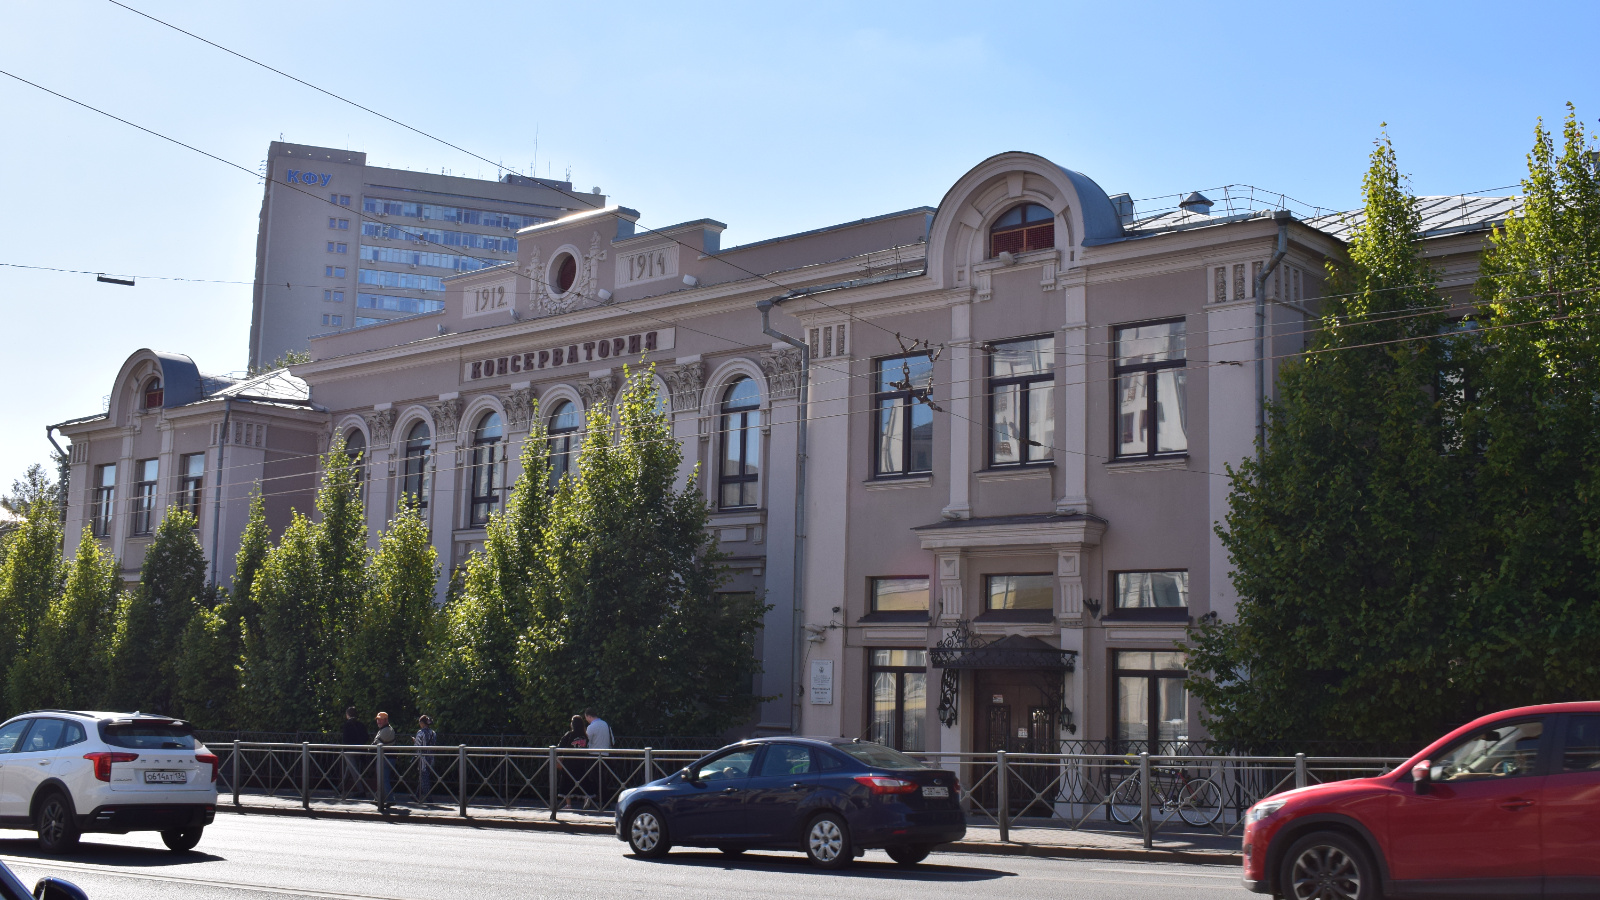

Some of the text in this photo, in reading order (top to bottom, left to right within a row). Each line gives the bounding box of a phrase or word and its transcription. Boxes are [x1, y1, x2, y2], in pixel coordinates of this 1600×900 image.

[287, 169, 332, 187] КФУ
[629, 252, 665, 281] 1914
[475, 286, 507, 311] 1912
[471, 331, 658, 380] КОНСЕРВАТОРИЯ
